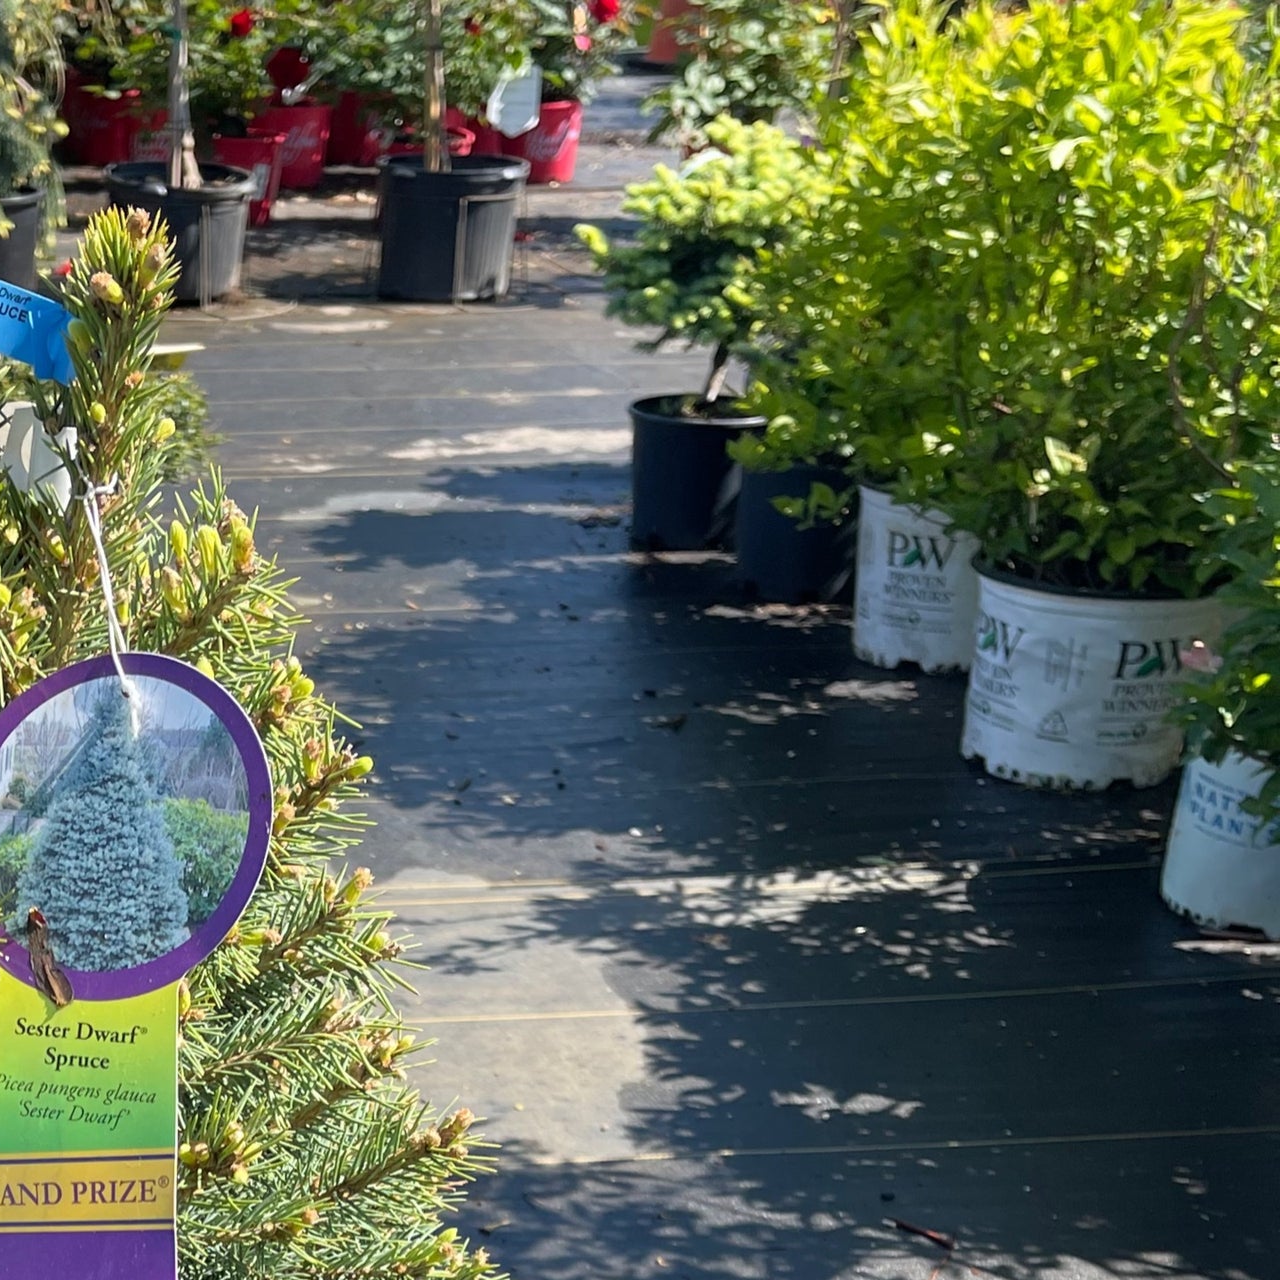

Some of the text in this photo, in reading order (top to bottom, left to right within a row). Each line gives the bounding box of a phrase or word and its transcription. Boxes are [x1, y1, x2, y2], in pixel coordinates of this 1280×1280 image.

[14, 1017, 71, 1039] Sester
[44, 1046, 110, 1071] Spruce
[35, 1081, 102, 1102] pungens
[103, 1082, 157, 1105] glauca
